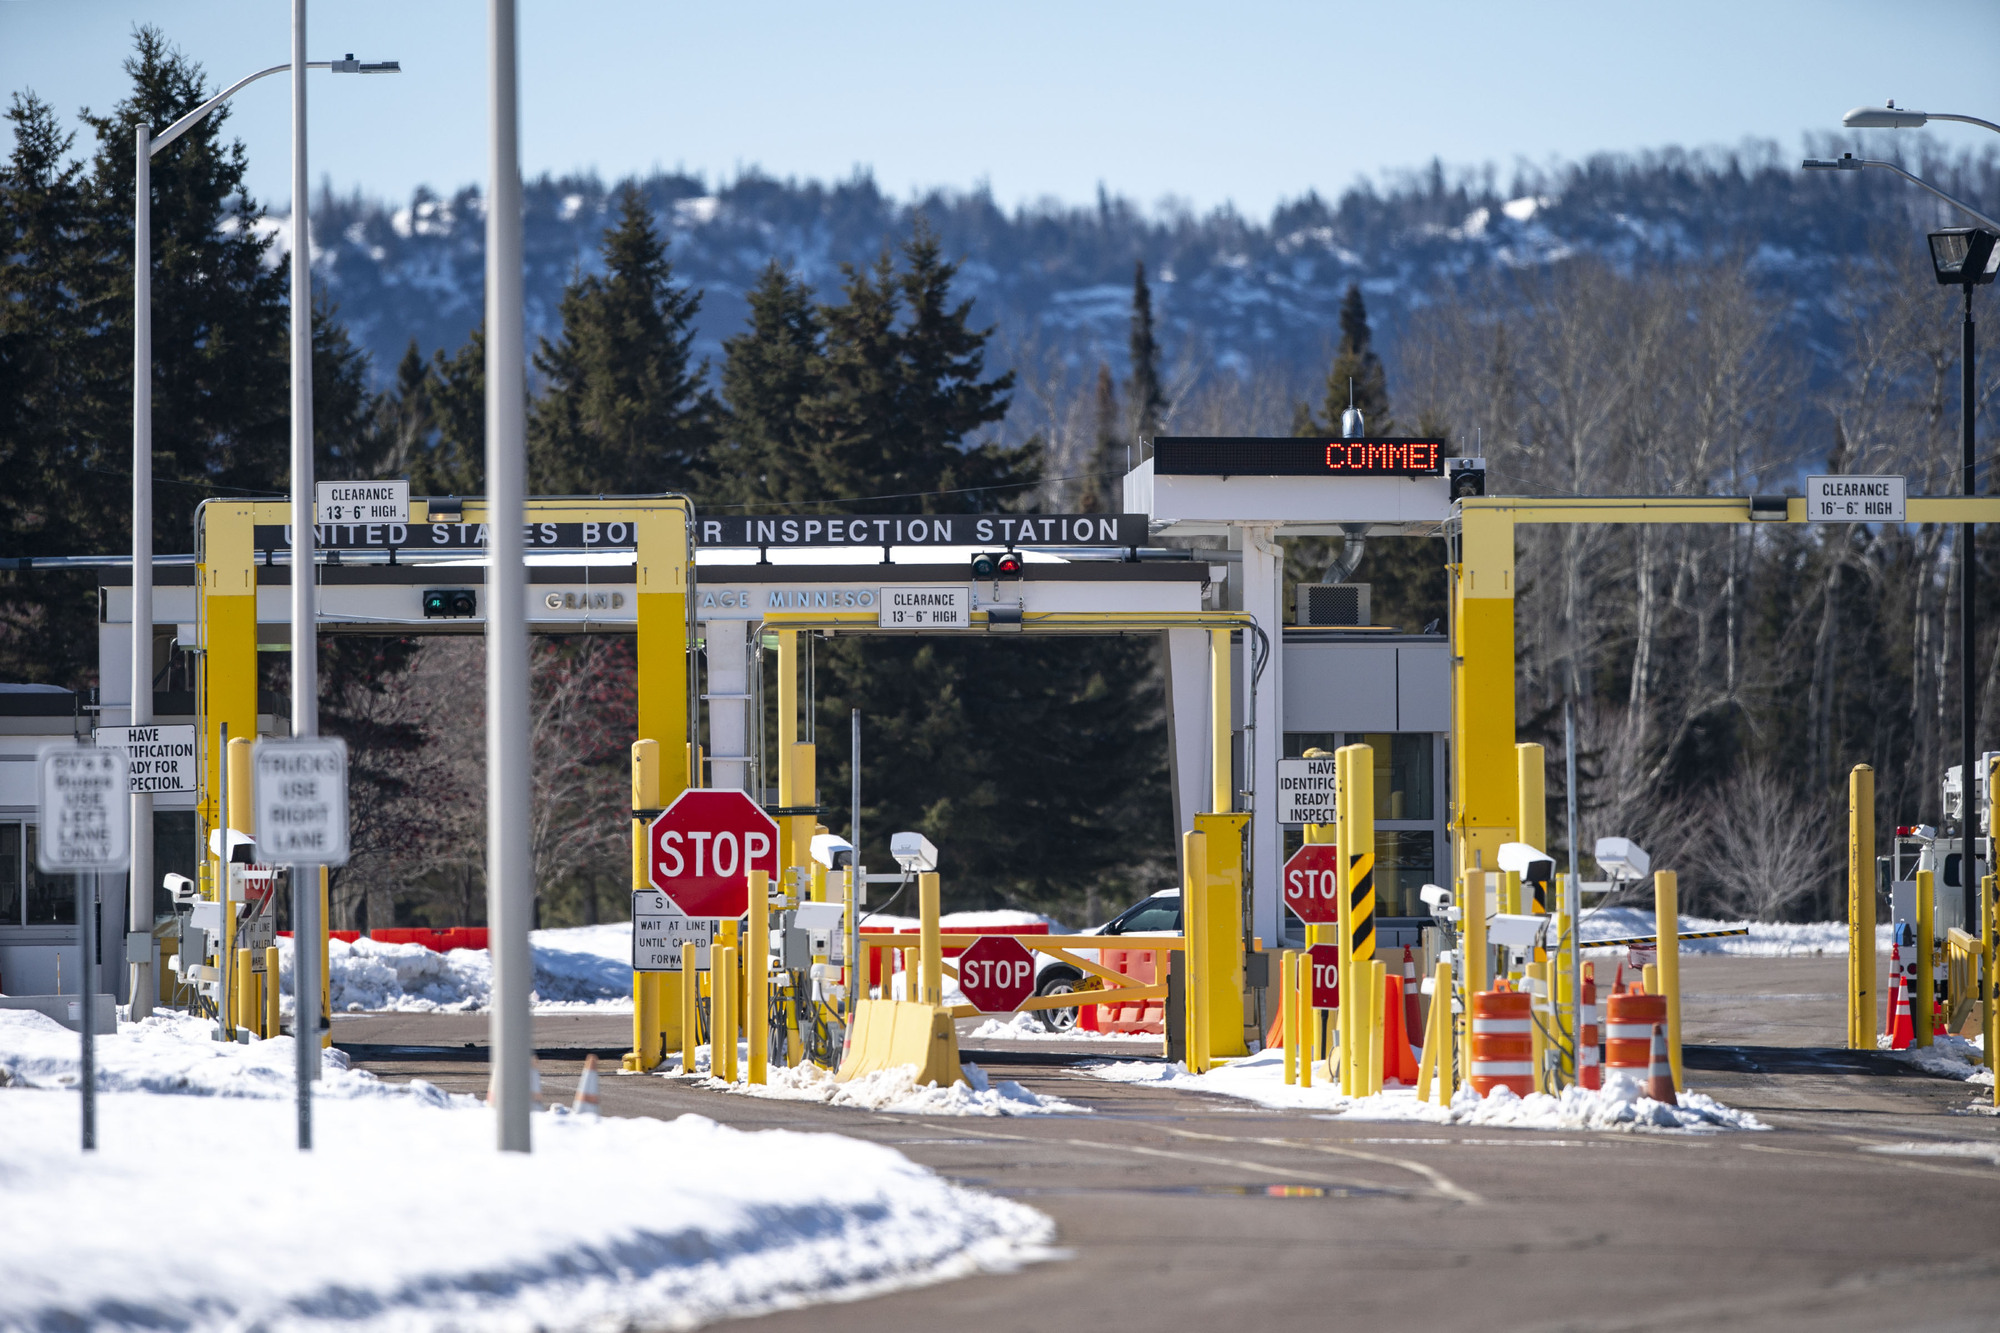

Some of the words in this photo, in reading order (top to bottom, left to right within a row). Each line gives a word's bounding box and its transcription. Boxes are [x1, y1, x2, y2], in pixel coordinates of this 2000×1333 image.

[331, 487, 394, 501] CLEARANCE
[1822, 483, 1890, 496] CLEARANCE
[371, 505, 397, 518] HIGH
[1865, 502, 1893, 515] HIGH
[432, 522, 558, 544] STAES
[582, 521, 722, 544] BOR
[746, 519, 952, 543] INSPECTION
[976, 518, 1118, 542] STATION
[545, 592, 625, 611] GRAND
[768, 590, 880, 609] MINNESO
[894, 593, 955, 606] CLEARANCE
[933, 610, 957, 623] HIGH
[128, 728, 159, 742] HAVE
[125, 743, 193, 758] TIFICATION
[129, 761, 152, 774] ADY
[155, 760, 178, 774] FOR
[1308, 762, 1336, 774] HAVE
[130, 776, 184, 791] PECTION.
[1280, 777, 1335, 790] IDENTIFIC
[1294, 793, 1330, 805] READY
[1290, 808, 1335, 821] INSPECT
[659, 830, 771, 878] STOP
[1288, 869, 1336, 899] STO
[640, 921, 661, 930] WAIT
[668, 921, 679, 930] AT
[686, 921, 706, 931] LINE
[640, 938, 665, 947] UNTIL
[651, 954, 682, 964] FORWA
[963, 960, 1032, 989] STOP
[1313, 964, 1338, 989] TO
